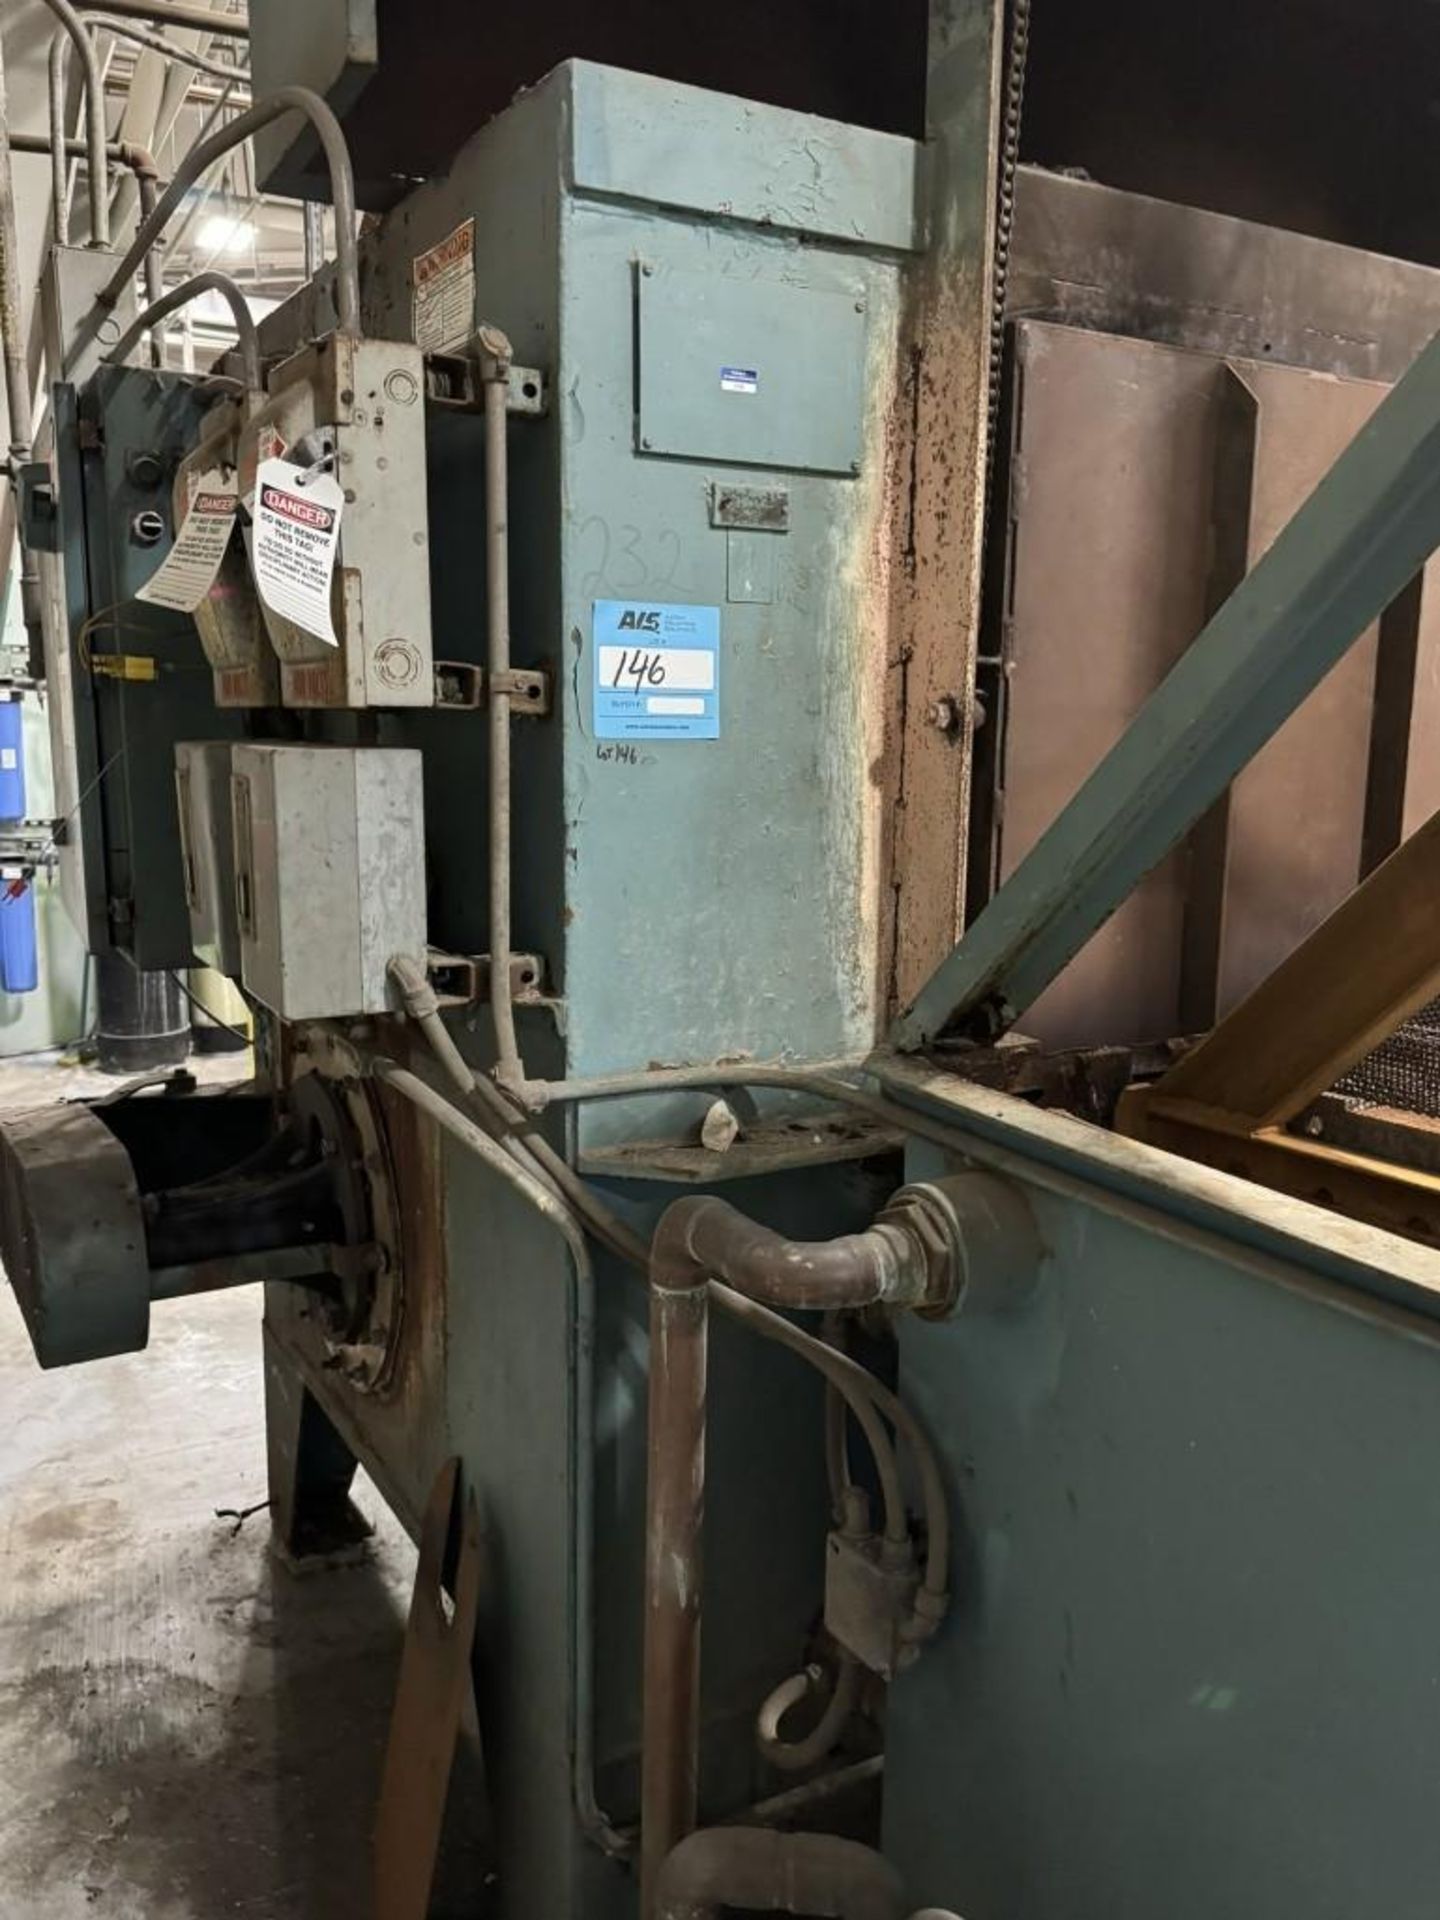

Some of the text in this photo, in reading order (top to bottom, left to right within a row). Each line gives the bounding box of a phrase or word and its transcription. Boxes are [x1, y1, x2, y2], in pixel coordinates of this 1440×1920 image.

[268, 490, 327, 526] DANGER
[261, 512, 330, 547] DO NOT REMOVE
[275, 528, 293, 544] THIS
[580, 515, 693, 598] 232
[613, 650, 666, 695] 146
[615, 744, 638, 764] 146
